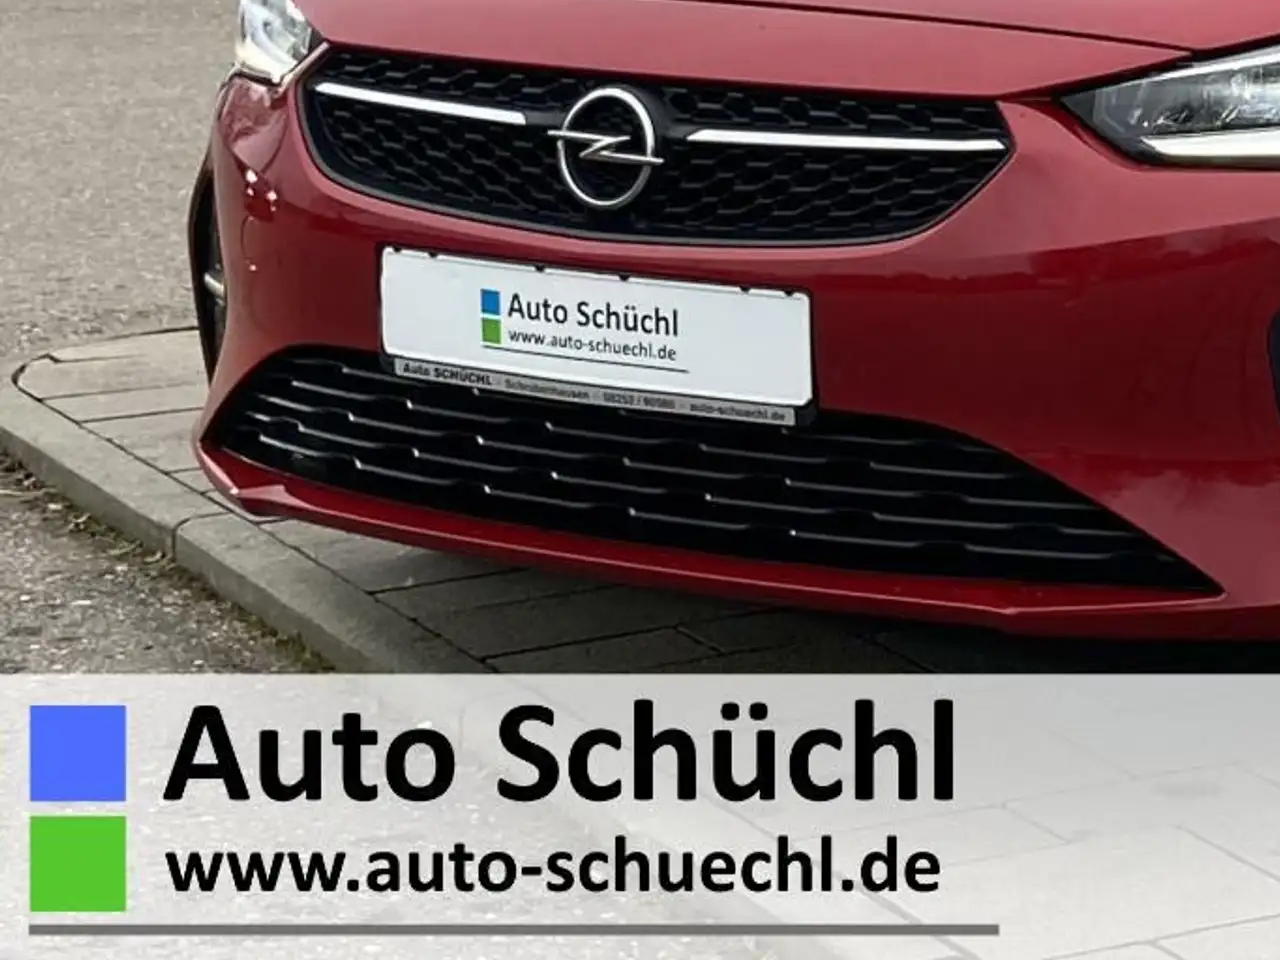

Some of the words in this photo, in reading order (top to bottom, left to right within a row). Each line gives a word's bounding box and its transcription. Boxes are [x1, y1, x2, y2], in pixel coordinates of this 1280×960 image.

[507, 292, 569, 325] Auto
[575, 301, 679, 338] Schüchl
[507, 329, 677, 362] www.auto-schuechl.de
[402, 363, 431, 376] Auto
